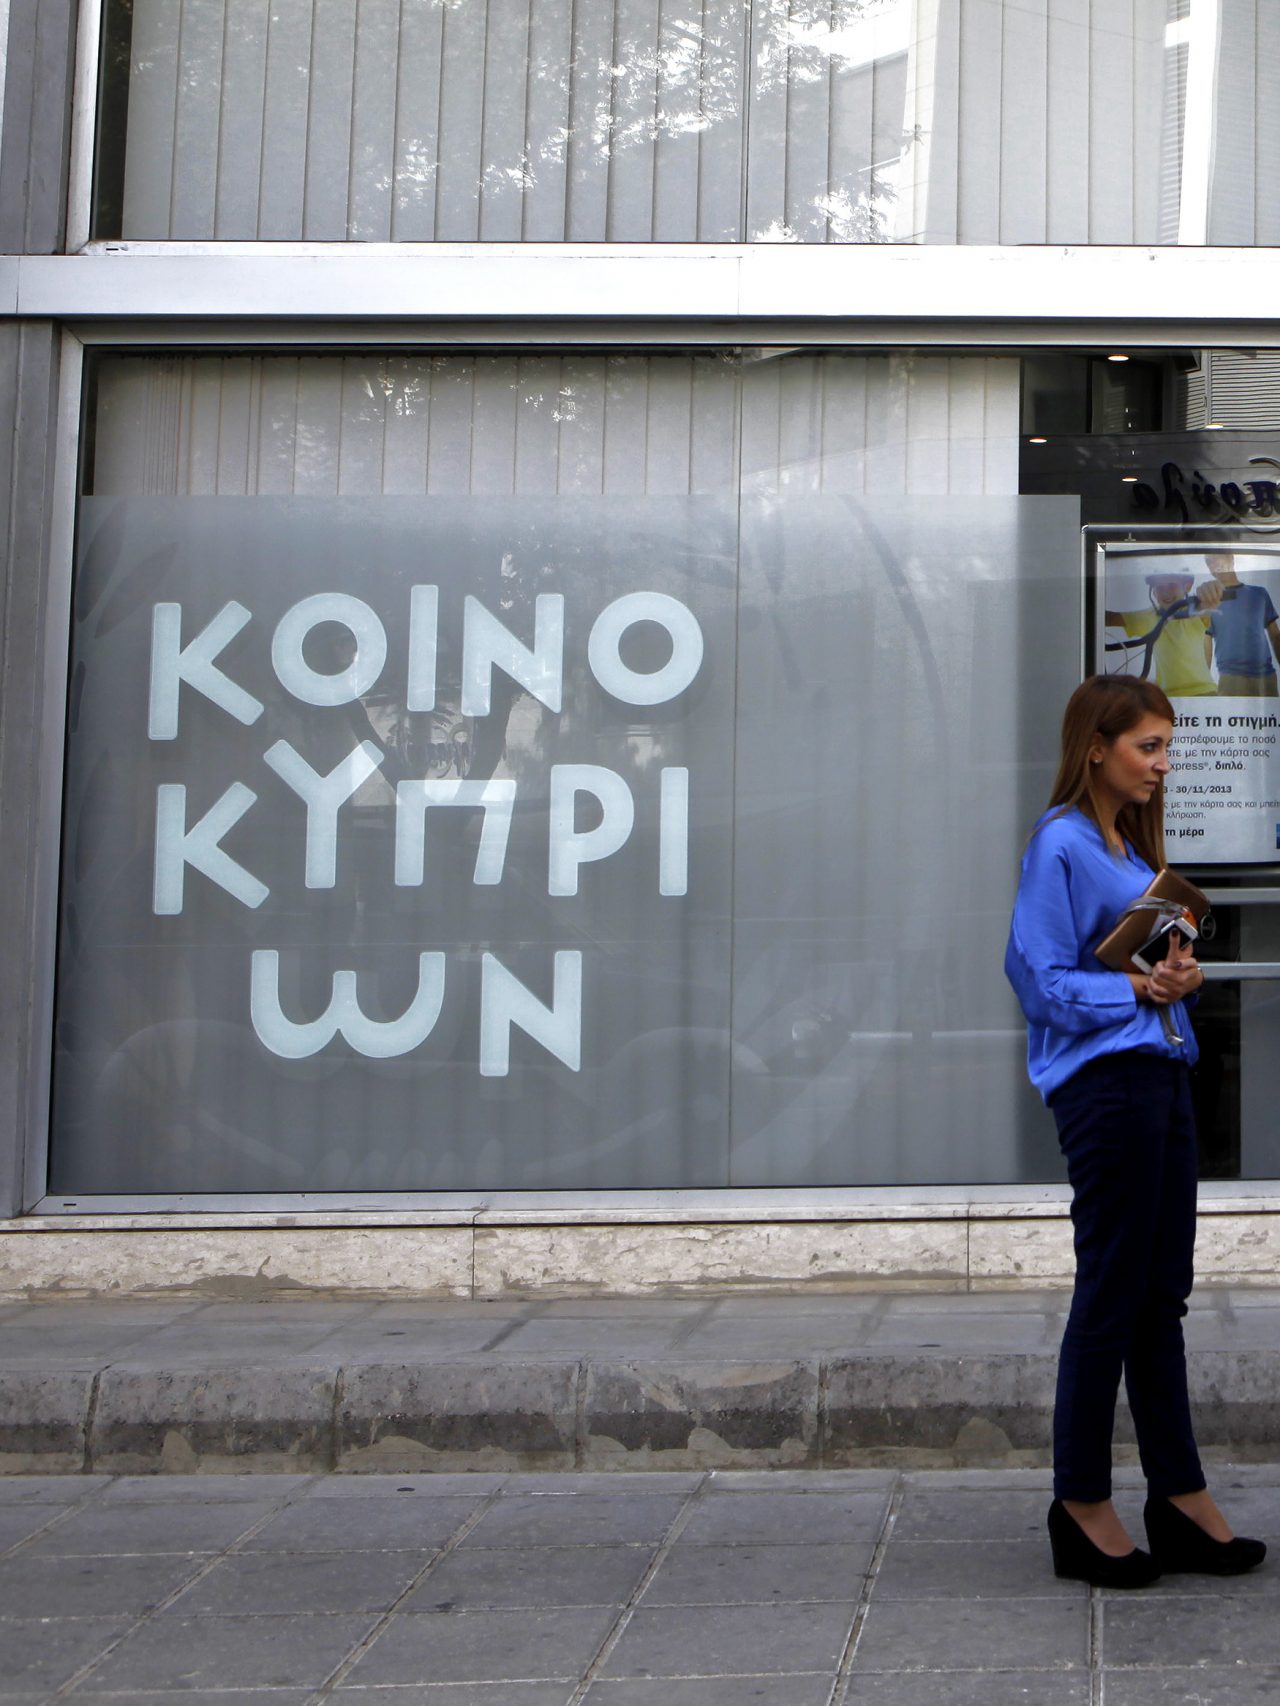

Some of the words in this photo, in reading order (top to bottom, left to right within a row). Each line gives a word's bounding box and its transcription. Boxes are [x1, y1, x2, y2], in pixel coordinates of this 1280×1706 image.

[1171, 713, 1200, 728] είτε
[1205, 716, 1222, 728] τη
[1171, 734, 1235, 745] πιστρέφουμε
[1238, 736, 1249, 744] το
[1185, 749, 1198, 758] με
[1201, 749, 1217, 758] την
[1220, 747, 1250, 758] κάρτα
[1252, 749, 1271, 758] σας
[1175, 785, 1232, 795] 30/11/2013
[1171, 801, 1181, 809] με
[1200, 799, 1225, 809] κάρτα
[1227, 801, 1242, 809] σας
[1179, 827, 1205, 838] μέρα
